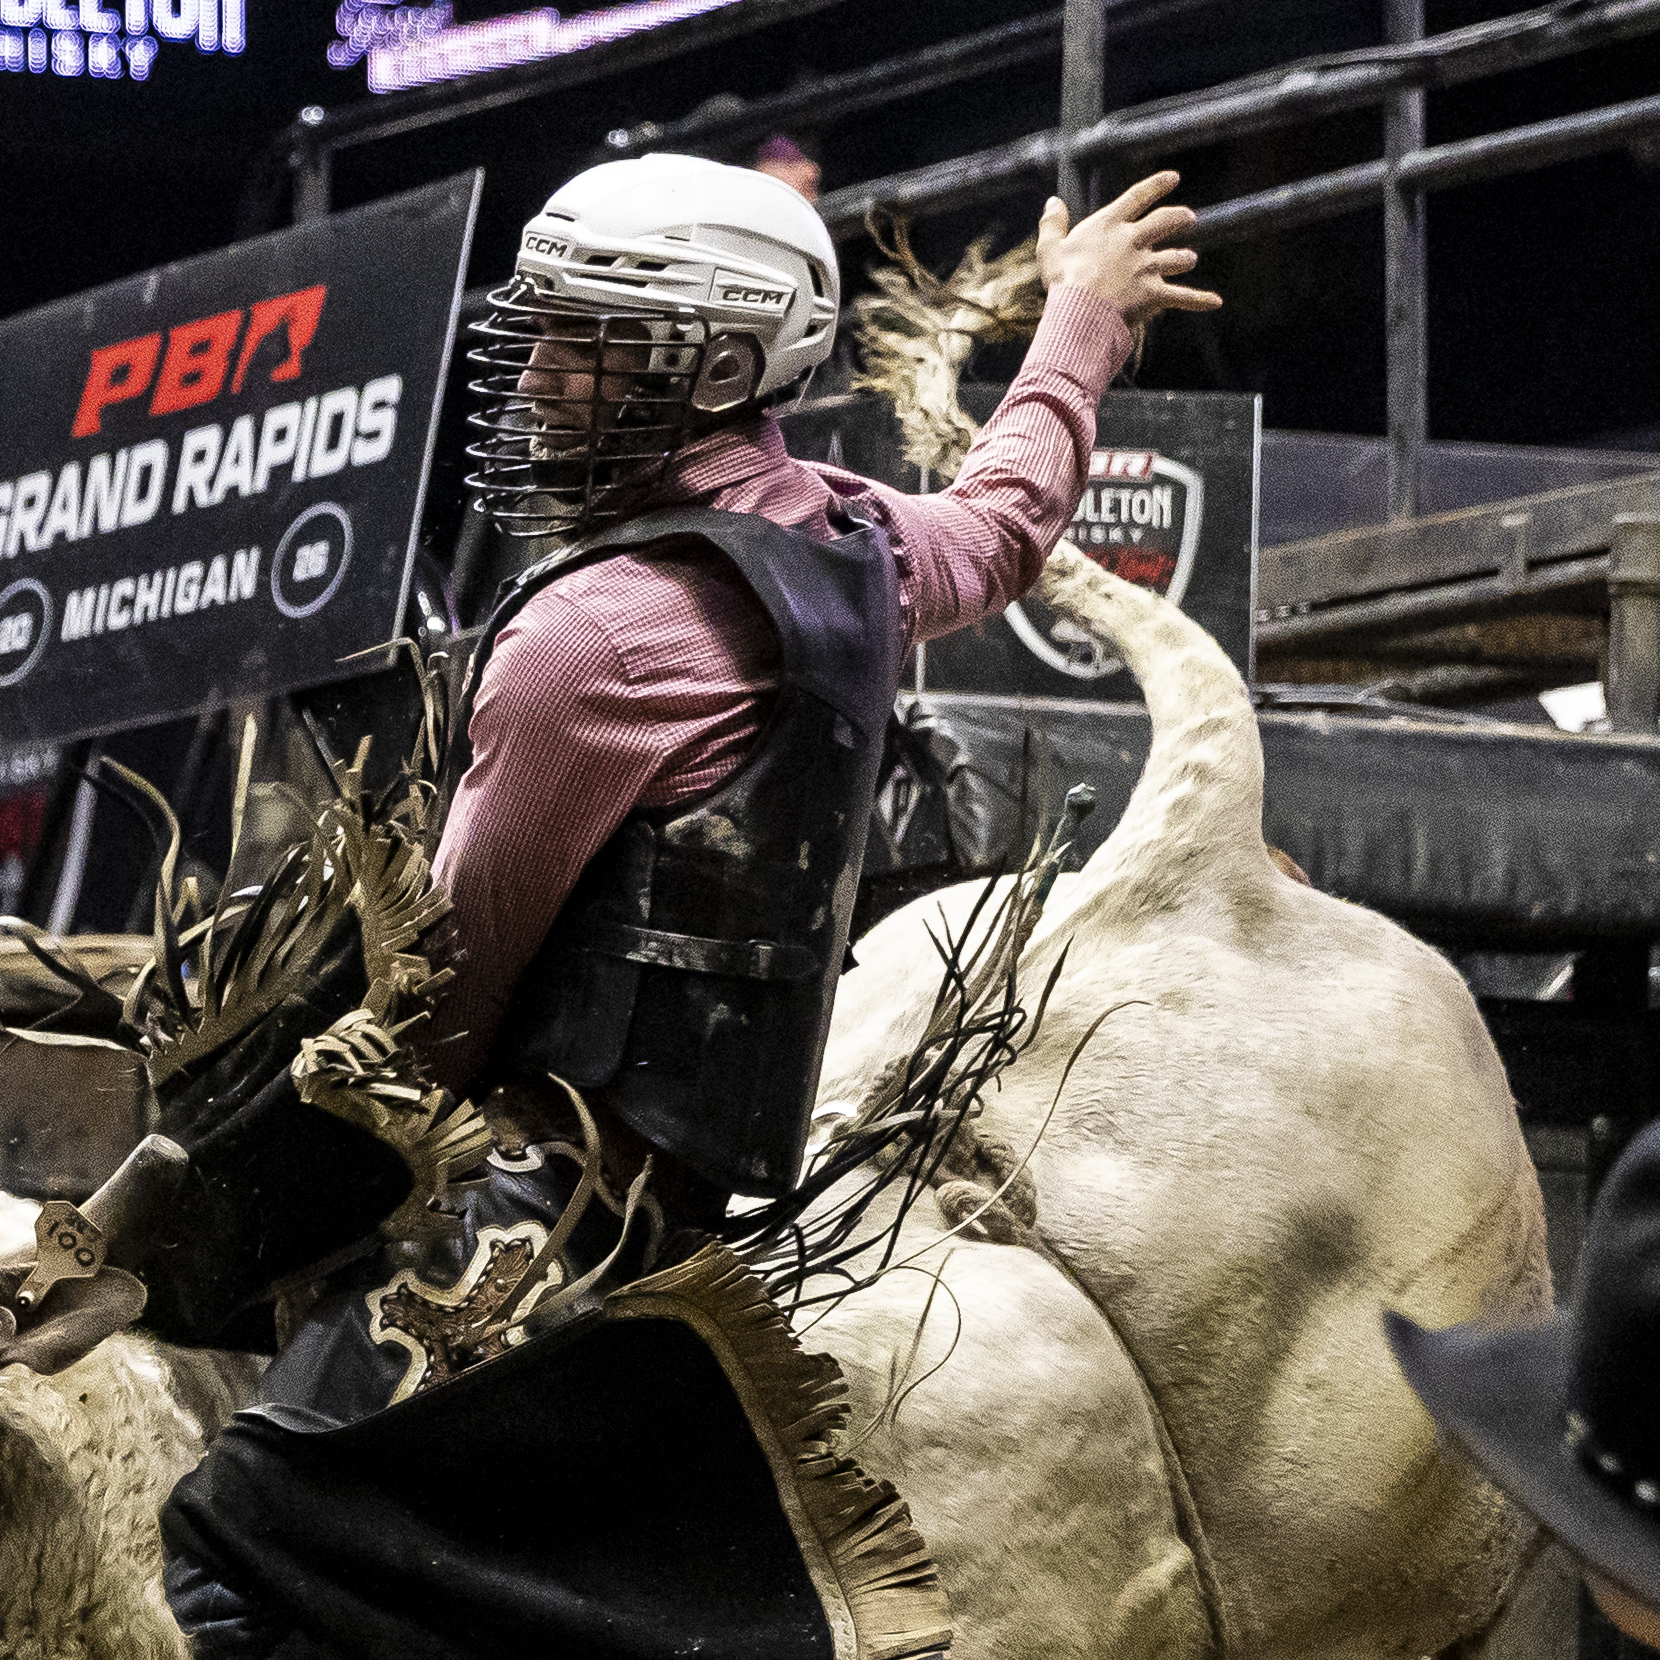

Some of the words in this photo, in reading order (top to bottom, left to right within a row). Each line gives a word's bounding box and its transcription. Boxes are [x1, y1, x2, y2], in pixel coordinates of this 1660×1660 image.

[525, 236, 568, 258] CCM
[721, 289, 785, 305] CCM
[170, 374, 403, 512] RAPIDS
[60, 546, 262, 643] MICHIGAN
